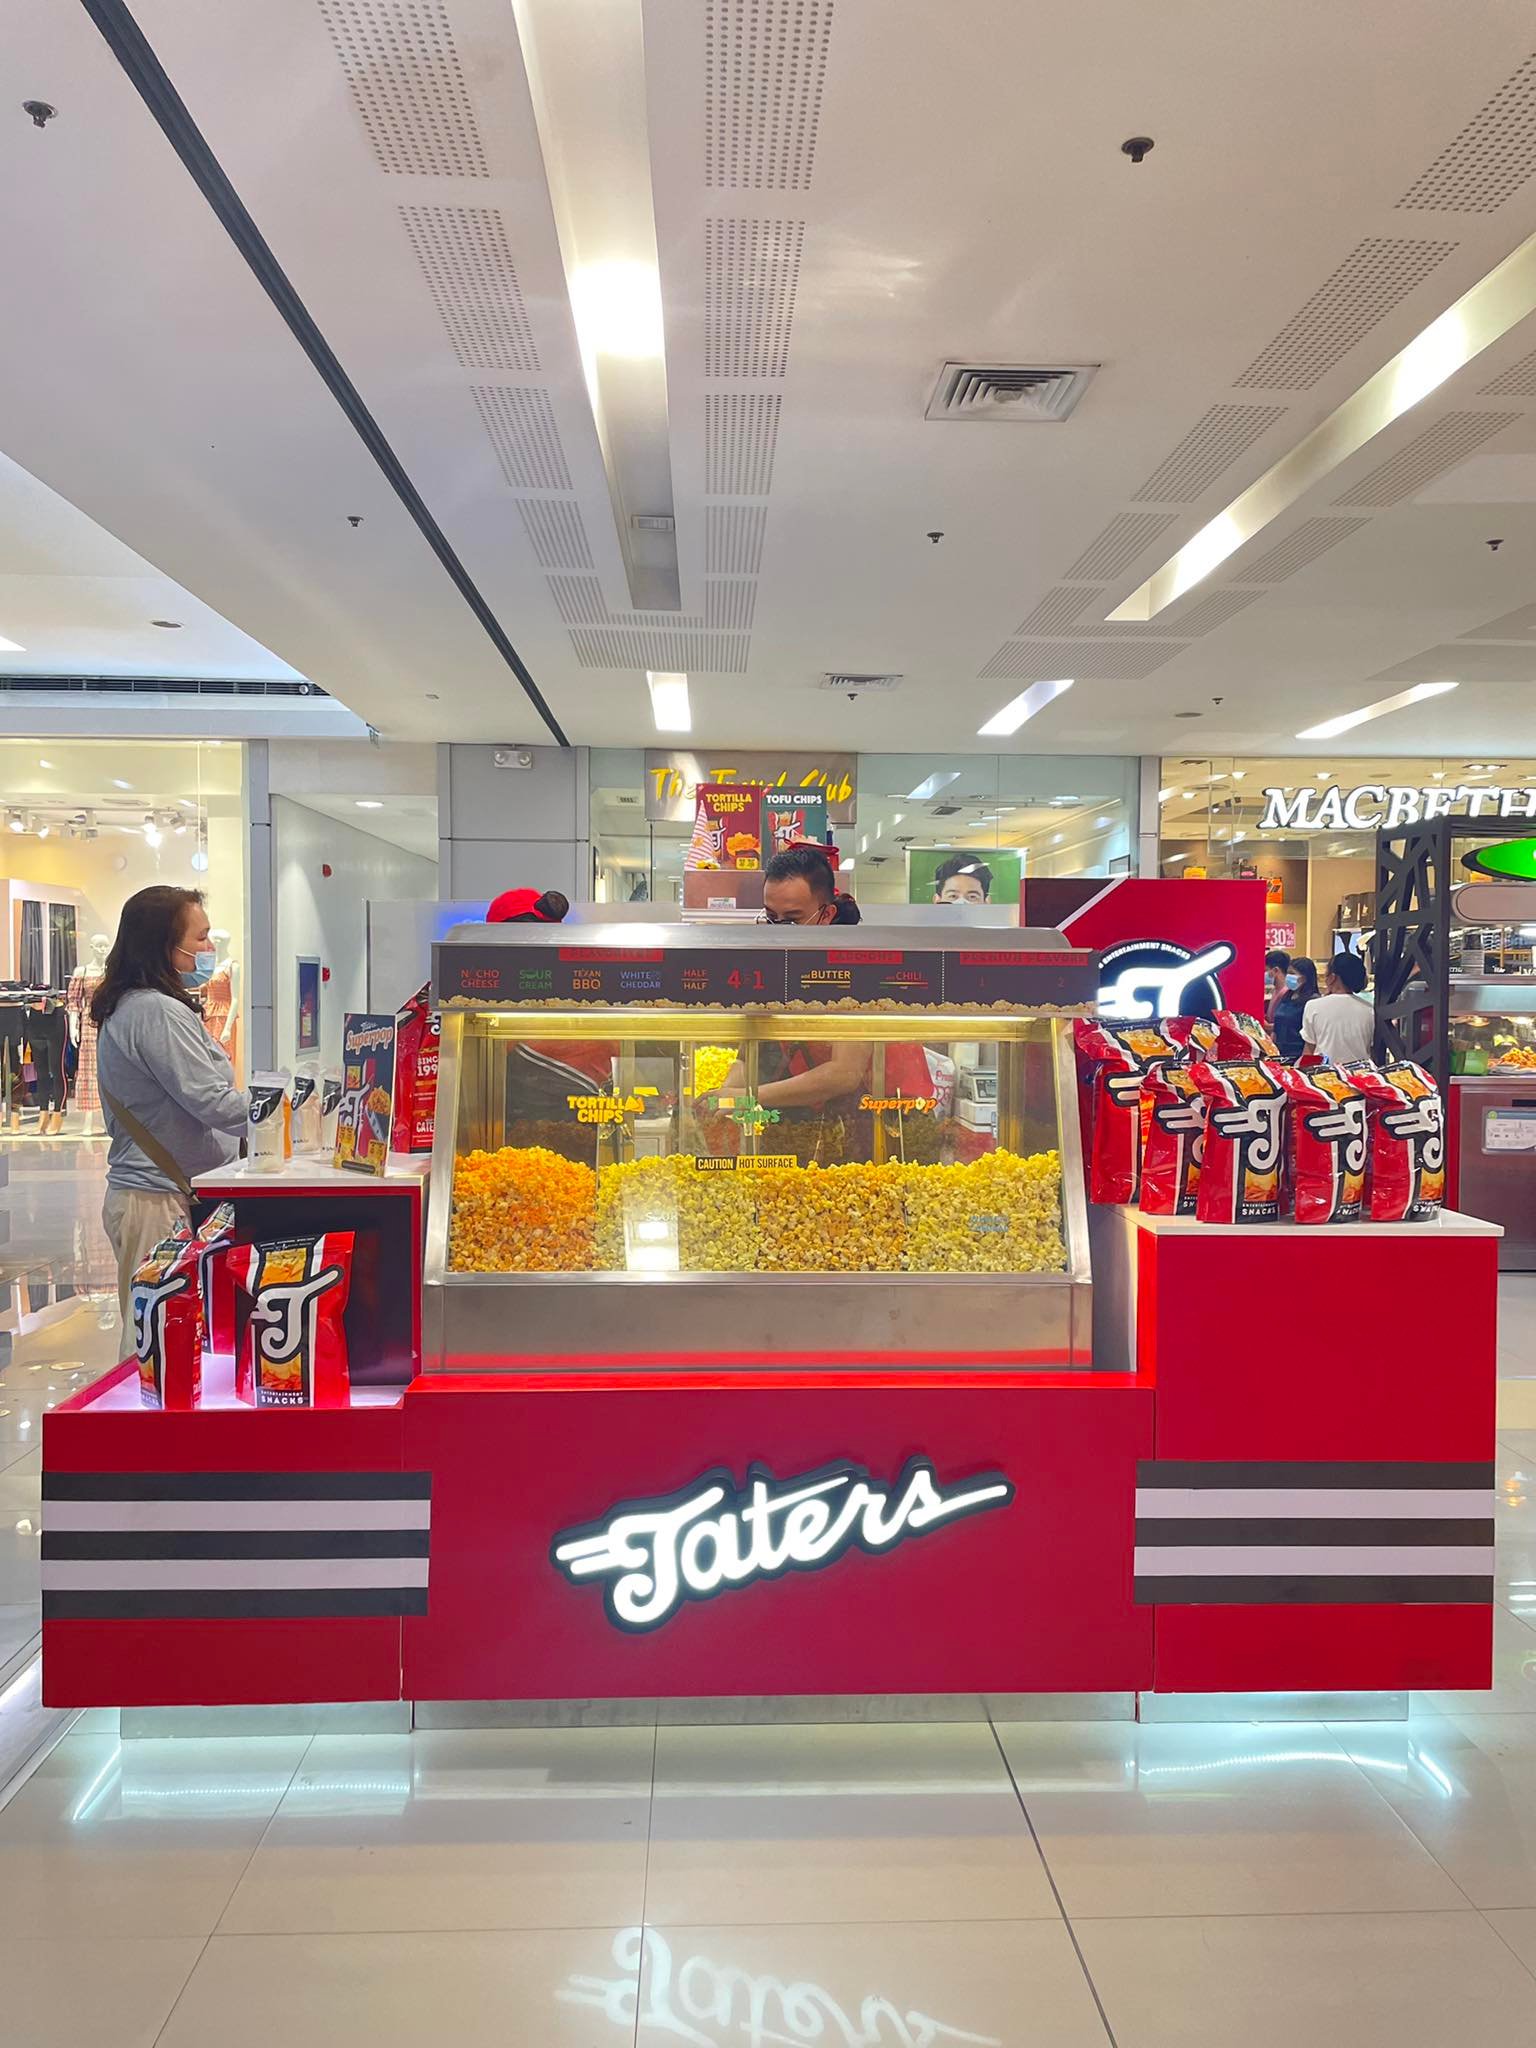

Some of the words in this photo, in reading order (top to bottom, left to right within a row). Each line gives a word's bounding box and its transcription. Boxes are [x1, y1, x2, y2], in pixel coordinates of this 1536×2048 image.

[650, 768, 699, 800] The
[705, 793, 753, 803] TORTILLA
[766, 794, 791, 804] TOFU
[793, 794, 822, 804] CHIPS
[713, 802, 745, 812] CHIPS
[1257, 785, 1536, 829] MACBETH
[573, 969, 601, 977] TEXAN
[620, 971, 651, 979] WHITE
[683, 969, 707, 977] HALF
[811, 970, 851, 979] BUTTER
[461, 979, 500, 988] CHEESE
[573, 979, 601, 990] BBQ
[727, 969, 741, 990] 4
[753, 970, 765, 990] 1
[519, 981, 552, 990] CREAM
[620, 981, 662, 989] CHEDDAR
[683, 982, 708, 990] HALF
[345, 1026, 393, 1055] Superpop
[417, 1056, 438, 1066] SINC
[417, 1065, 438, 1077] 199
[859, 1096, 937, 1115] Superpop
[577, 1109, 624, 1123] CHIPS
[697, 1158, 734, 1169] CAUTION
[739, 1158, 755, 1169] HOT
[757, 1157, 794, 1168] SURFACE
[1242, 1207, 1276, 1216] SNACKS
[261, 1396, 304, 1405] SNACKS
[556, 1470, 1007, 1623] Taters
